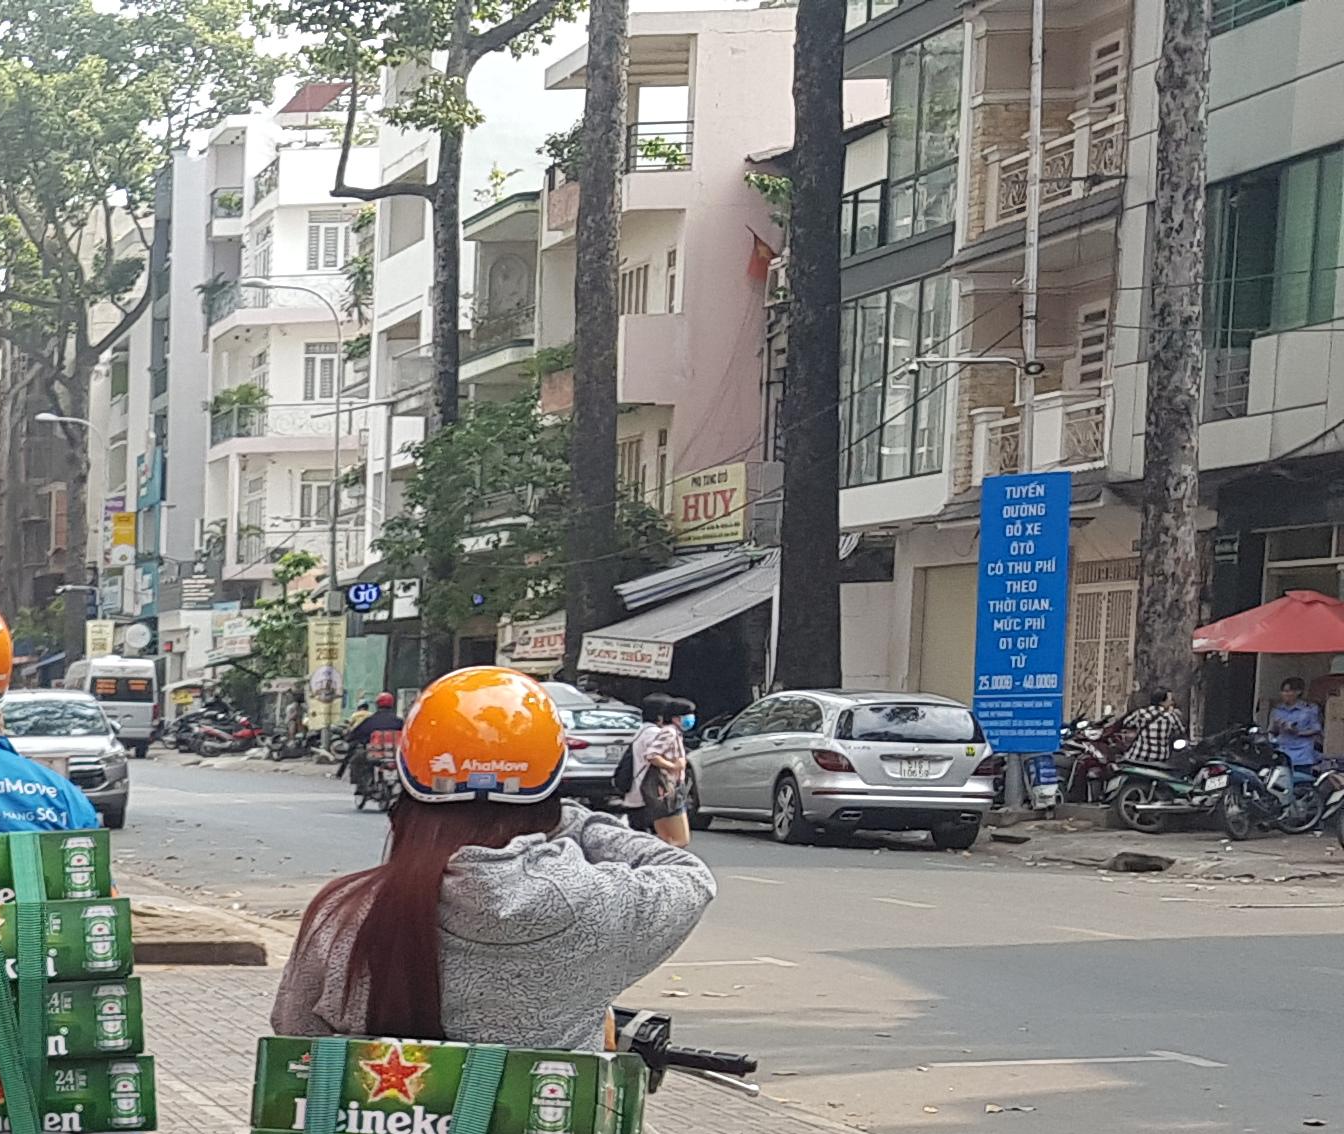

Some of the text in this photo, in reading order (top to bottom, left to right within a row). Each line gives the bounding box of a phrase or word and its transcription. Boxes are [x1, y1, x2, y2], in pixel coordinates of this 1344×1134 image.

[1004, 483, 1045, 500] TUYẾN
[682, 487, 737, 523] HUY
[1002, 503, 1046, 518] ĐƯỜNG
[1025, 524, 1042, 536] XE
[1010, 540, 1035, 556] ÔTÔ
[987, 556, 1057, 576] CÓ THU PHÍ
[1005, 580, 1037, 594] THEO
[993, 614, 1046, 632] MỨC PHÍ
[999, 633, 1039, 650] 01 GIỜ
[460, 757, 529, 773] AhaMove
[54, 1070, 74, 1085] 24
